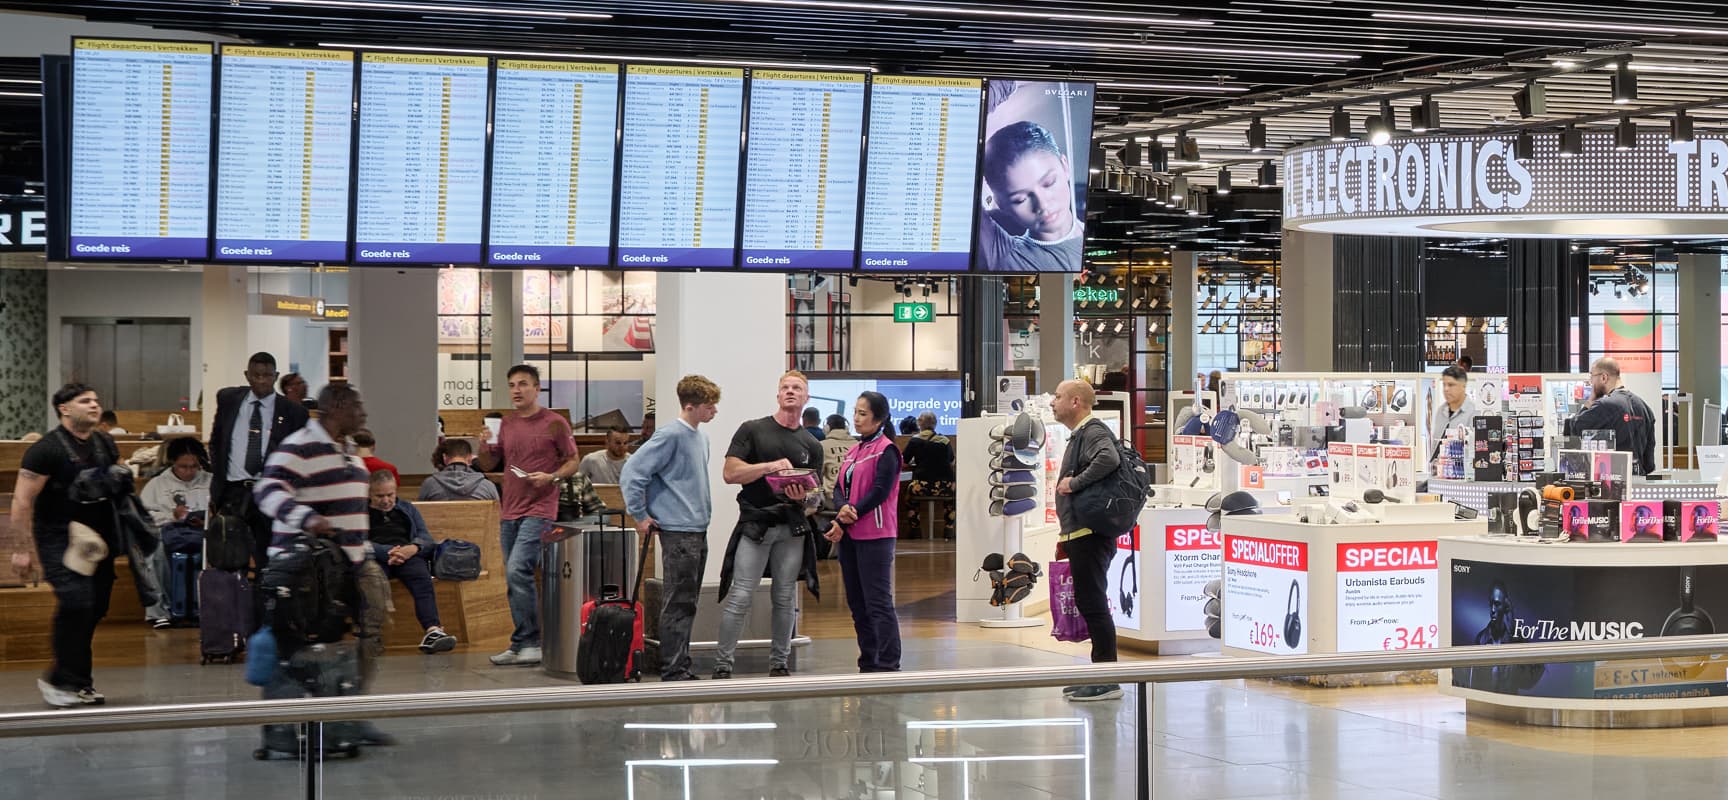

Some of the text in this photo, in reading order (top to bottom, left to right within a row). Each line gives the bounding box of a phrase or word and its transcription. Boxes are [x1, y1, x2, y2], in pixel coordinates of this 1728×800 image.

[234, 48, 255, 56] Flight
[257, 50, 296, 58] departures
[374, 55, 394, 63] Flight
[395, 56, 432, 64] departures
[530, 63, 566, 71] departures
[762, 72, 781, 80] Flight
[1302, 140, 1532, 216] ELECTRONICS
[76, 243, 131, 253] Goede reis
[220, 246, 272, 256] Goede reis
[360, 249, 410, 258] Goede reis
[493, 251, 541, 261] Goede reis
[622, 254, 668, 263] Goede reis
[746, 255, 790, 265] Goede reis
[865, 257, 908, 266] Goede reis
[889, 398, 940, 411] Upgrade
[1588, 516, 1609, 524] MUSIC
[1174, 553, 1199, 561] Xtorm
[1232, 538, 1299, 567] SPECIALOFFER
[1345, 546, 1438, 568] SPECIAL
[1227, 566, 1237, 576] Sony
[1453, 565, 1470, 574] SONY
[1345, 576, 1425, 587] Urbanista Earbuds
[1570, 621, 1644, 641] MUSIC
